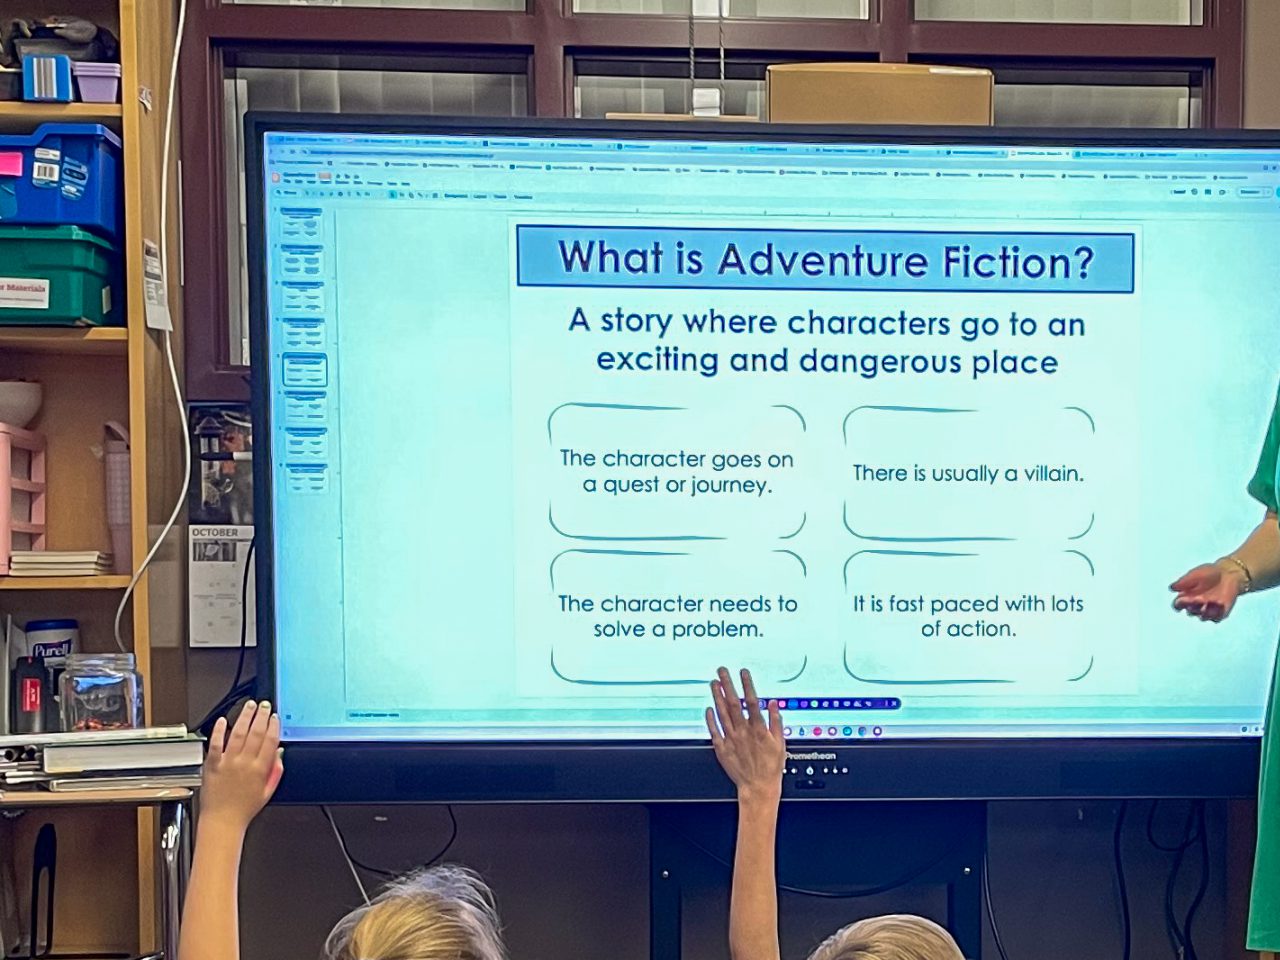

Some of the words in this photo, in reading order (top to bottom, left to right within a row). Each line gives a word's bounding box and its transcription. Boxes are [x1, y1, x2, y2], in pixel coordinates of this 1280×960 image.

[558, 239, 664, 274] What
[676, 240, 704, 275] is
[717, 242, 929, 278] Adventure
[944, 244, 1095, 280] Fiction?
[568, 306, 591, 332] A
[601, 307, 673, 339] story
[683, 308, 778, 334] where
[787, 309, 951, 336] characters
[960, 316, 1000, 342] go
[1009, 312, 1038, 337] to
[1048, 316, 1086, 337] an
[596, 345, 719, 377] exciting
[729, 347, 789, 372] and
[799, 348, 962, 379] dangerous
[972, 349, 1059, 380] place
[560, 448, 596, 467] The
[602, 449, 706, 468] character
[712, 453, 762, 471] goes
[768, 453, 794, 468] on
[853, 464, 908, 482] There
[914, 463, 926, 482] is
[932, 464, 999, 485] usually
[1004, 468, 1018, 482] a
[1024, 464, 1085, 482] villain.
[582, 478, 597, 493] a
[603, 475, 659, 496] quest
[665, 478, 686, 493] or
[691, 475, 773, 497] journey.
[192, 528, 238, 538] OCTOBER
[558, 594, 594, 612] The
[600, 594, 702, 613] character
[702, 595, 772, 612] needs
[778, 595, 798, 613] to
[853, 595, 866, 612] It
[871, 594, 883, 612] is
[889, 594, 925, 612] fast
[930, 595, 999, 616] paced
[1005, 594, 1045, 612] with
[1051, 594, 1084, 612] lots
[593, 620, 645, 638] solve
[652, 623, 666, 638] a
[672, 620, 764, 640] problem.
[921, 619, 941, 637] of
[947, 620, 1017, 637] action.
[784, 752, 837, 761] Promethean
